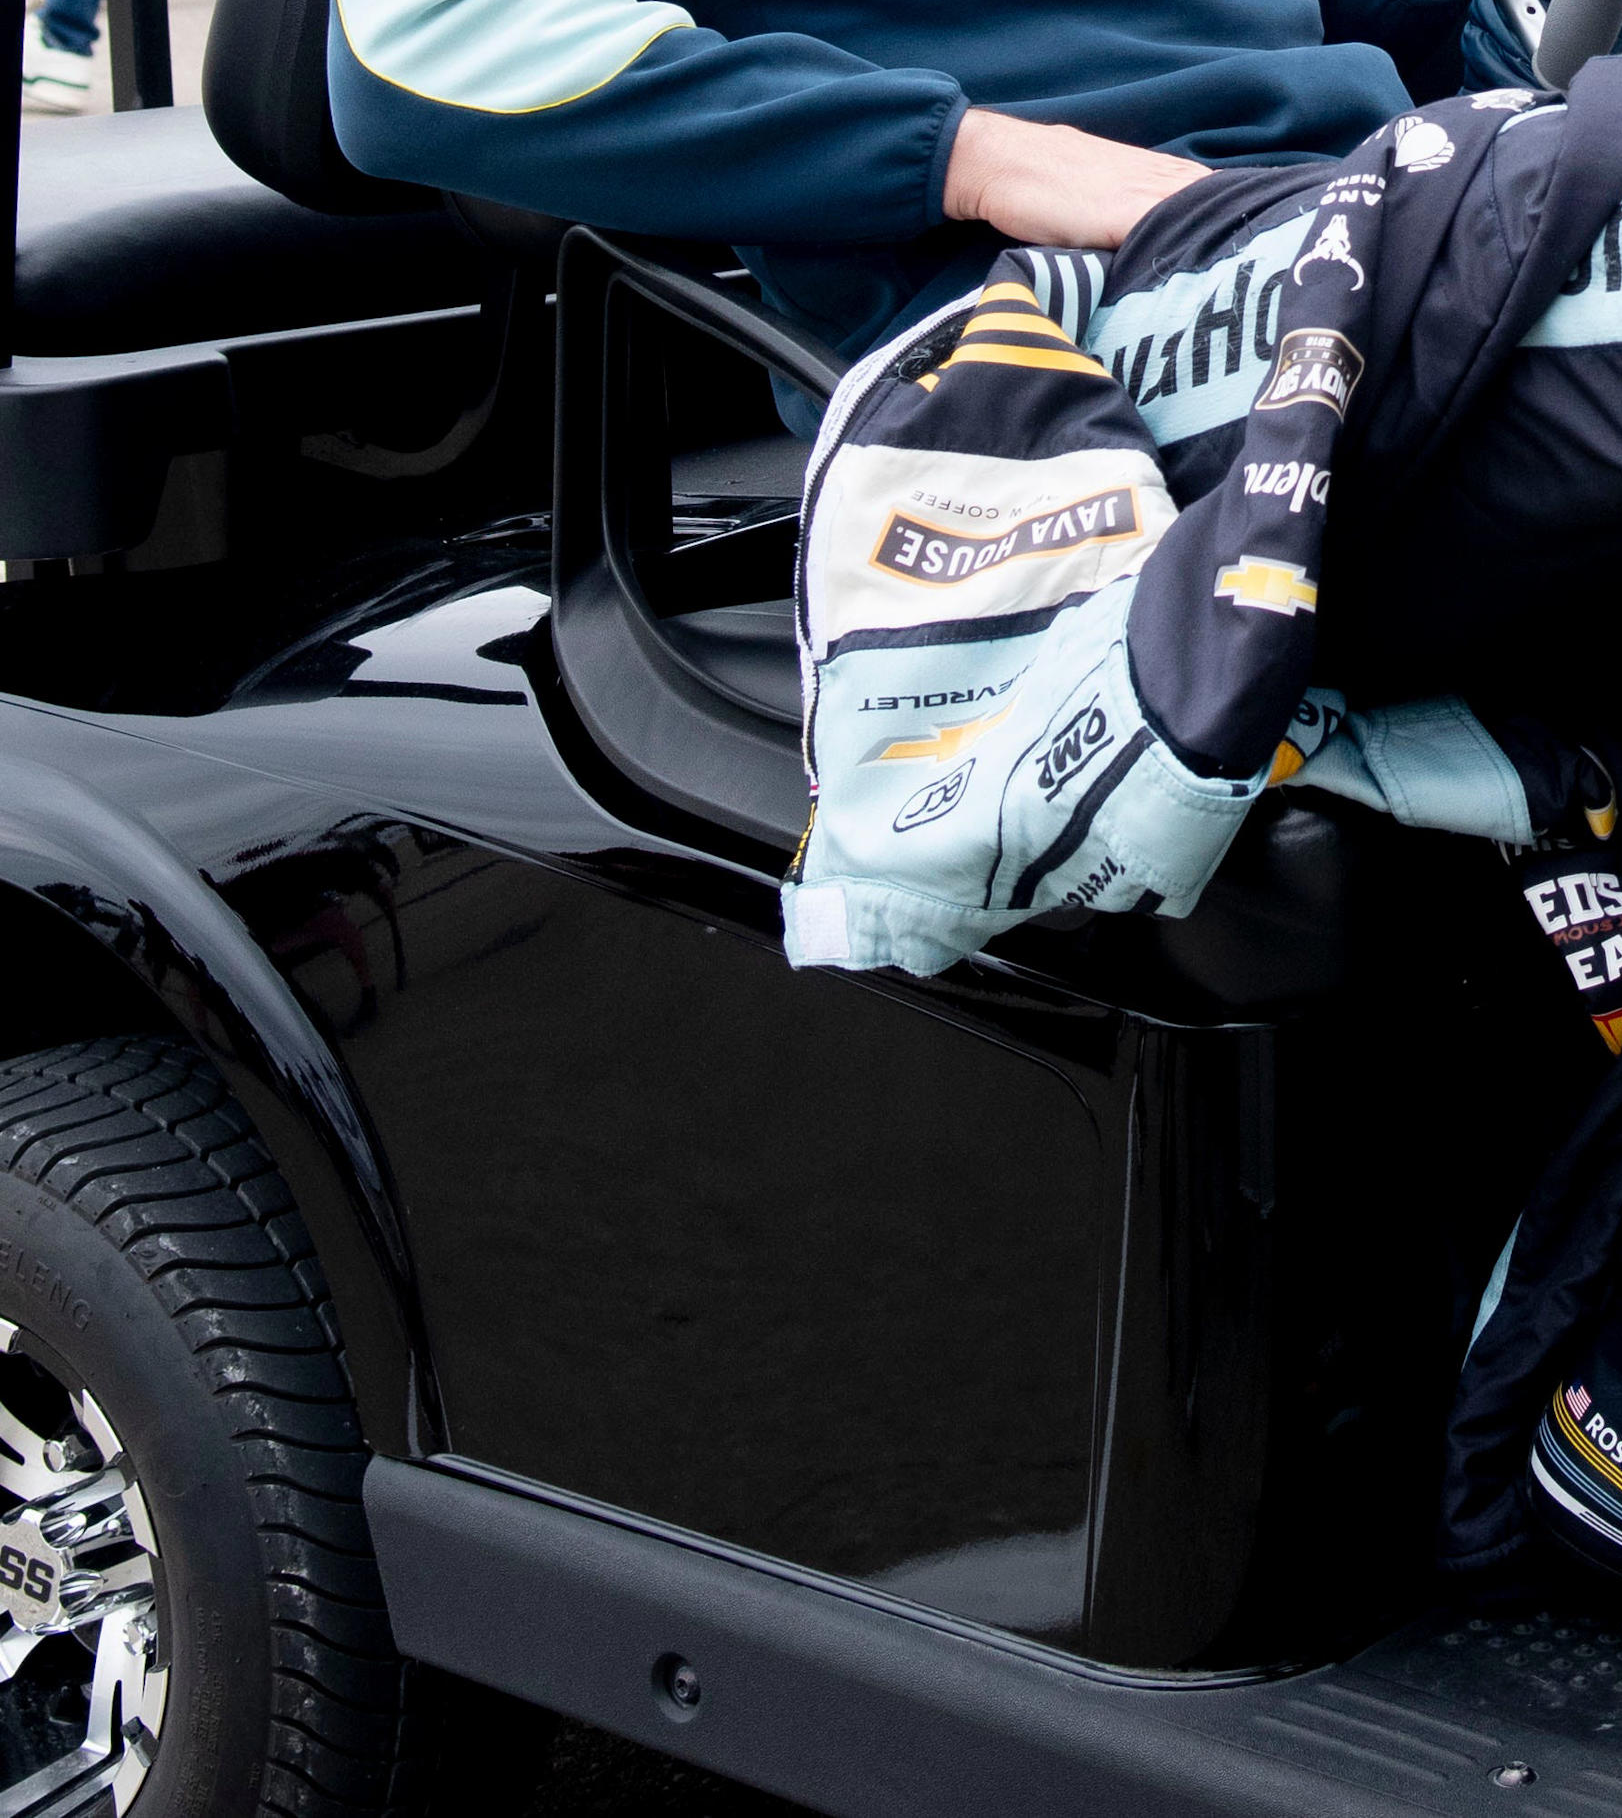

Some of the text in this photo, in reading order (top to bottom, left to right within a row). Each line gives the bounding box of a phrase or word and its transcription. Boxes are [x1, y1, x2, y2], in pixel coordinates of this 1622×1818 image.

[911, 489, 1000, 520] COFFEE
[1244, 460, 1332, 513] plen
[1032, 495, 1119, 545] JAVA
[1036, 707, 1107, 790] OMP
[905, 772, 963, 820] ecr
[1553, 918, 1618, 946] MOUS
